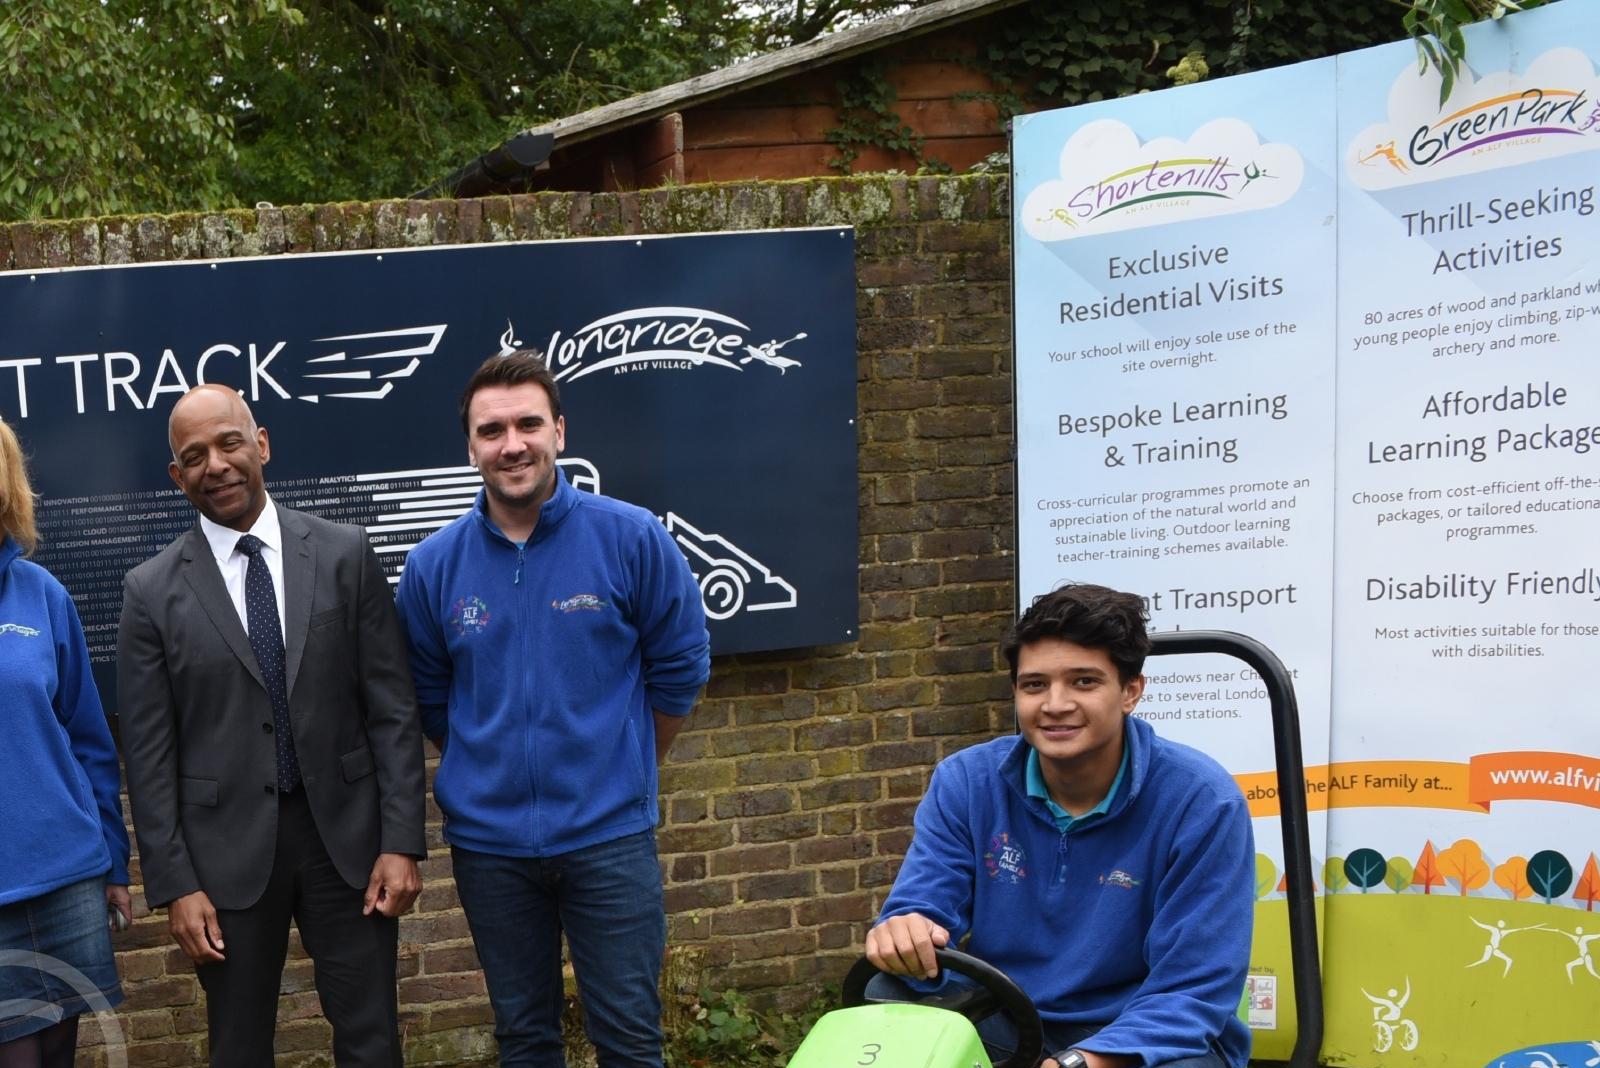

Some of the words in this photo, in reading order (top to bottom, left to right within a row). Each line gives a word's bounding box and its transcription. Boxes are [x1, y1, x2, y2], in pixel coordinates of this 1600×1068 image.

[1068, 156, 1240, 219] Shortenills
[1402, 187, 1594, 239] Thrill-Seeking
[1110, 245, 1228, 279] Exclusive
[1433, 235, 1561, 274] Activities
[1061, 283, 1201, 324] Residential
[1209, 276, 1283, 302] Visits
[1365, 312, 1382, 325] 80
[1387, 309, 1423, 322] acres
[1428, 302, 1442, 316] of
[1447, 296, 1485, 313] wood
[1491, 292, 1516, 308] and
[1522, 282, 1580, 307] parkland
[1049, 352, 1076, 362] Your
[1081, 343, 1122, 359] school
[1127, 339, 1149, 352] will
[1155, 336, 1191, 355] enjoy
[1196, 331, 1222, 344] sole
[1227, 330, 1250, 340] use
[1255, 324, 1269, 336] of
[1274, 322, 1296, 334] the
[1354, 333, 1398, 350] young
[1403, 324, 1449, 344] people
[1455, 319, 1492, 335] enjoy
[1498, 311, 1561, 327] climbing,
[1432, 340, 1485, 358] archery
[1490, 335, 1516, 351] and
[1520, 331, 1560, 346] more.
[614, 366, 628, 375] AN
[632, 363, 649, 372] ALF
[652, 360, 693, 371] VILLAGE
[1123, 361, 1145, 372] site
[1150, 352, 1216, 369] overnight.
[56, 341, 291, 414] TRACK
[1423, 382, 1566, 419] Affordable
[1059, 405, 1161, 437] Bespoke
[1174, 393, 1287, 423] Learning
[1105, 446, 1125, 467] &
[1132, 437, 1238, 464] Training
[1369, 434, 1486, 463] Learning
[319, 475, 356, 484] ANALYTICS
[348, 484, 389, 493] ADVANTAGE
[315, 497, 340, 505] MINING
[1037, 492, 1137, 513] Cross-curricular
[1142, 486, 1224, 507] programmes
[1230, 480, 1288, 497] promote
[1293, 479, 1309, 488] an
[1353, 492, 1403, 504] Choose
[1409, 488, 1441, 500] from
[1447, 481, 1540, 497] cost-efficient
[71, 505, 124, 515] PERFORMANCE
[128, 512, 168, 521] EDUCATION
[1050, 512, 1128, 533] appreciation
[1133, 508, 1145, 520] of
[1151, 508, 1171, 519] the
[1176, 502, 1223, 517] natural
[1228, 499, 1266, 512] world
[1272, 496, 1295, 509] and
[1378, 509, 1443, 526] packages,
[1448, 508, 1462, 517] or
[1467, 501, 1521, 516] tailored
[56, 540, 90, 549] DECISION
[91, 535, 142, 545] MANAGEMENT
[83, 527, 107, 535] CLOUD
[1056, 529, 1126, 545] sustainable
[1131, 527, 1168, 540] living.
[1173, 522, 1230, 535] Outdoor
[1235, 517, 1290, 531] learning
[1447, 524, 1537, 541] programmes.
[1058, 546, 1160, 562] teacher-training
[1164, 543, 1220, 555] schemes
[1225, 536, 1287, 550] available.
[1169, 584, 1296, 613] Transport
[1367, 574, 1496, 604] Disability
[1376, 628, 1408, 639] Most
[1414, 625, 1476, 638] activities
[1482, 624, 1536, 636] suitable
[1541, 623, 1559, 635] for
[1564, 623, 1598, 635] those
[1432, 645, 1462, 657] with
[1468, 644, 1544, 657] disabilities.
[1144, 671, 1202, 684] meadows
[1205, 670, 1238, 683] near
[1158, 690, 1172, 702] to
[1175, 688, 1221, 702] several
[1186, 705, 1242, 720] stations.
[1328, 774, 1358, 792] ALF
[1365, 773, 1418, 794] Family
[1423, 774, 1452, 791] at...
[1000, 851, 1021, 865] ALF
[857, 1043, 882, 1066] 3
